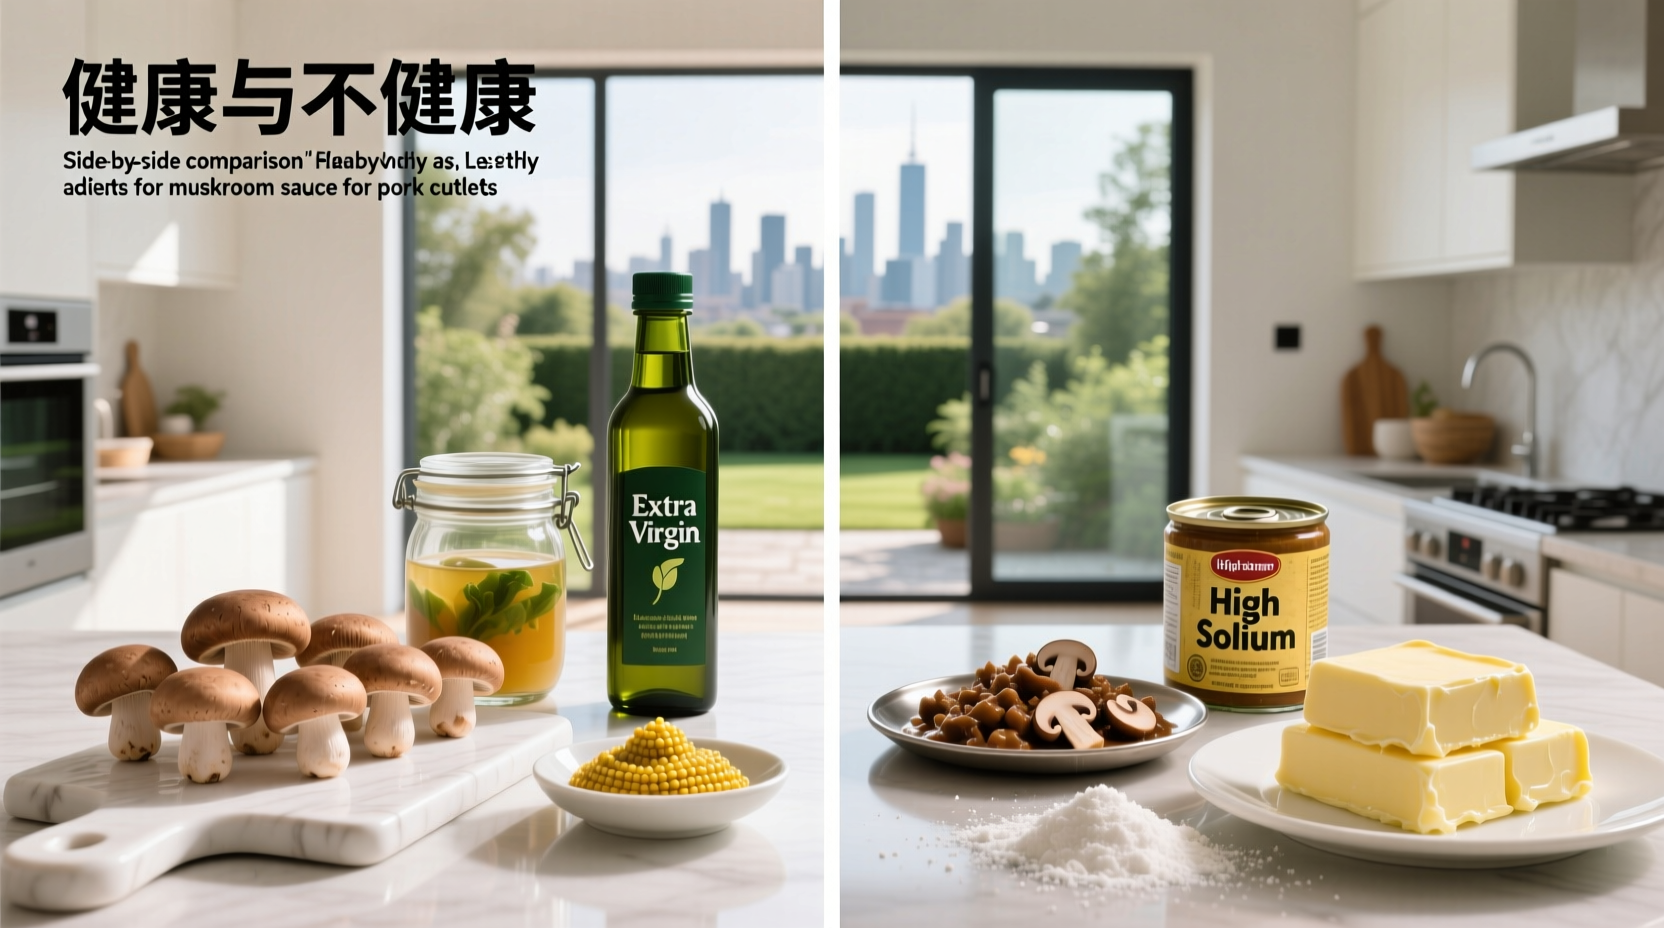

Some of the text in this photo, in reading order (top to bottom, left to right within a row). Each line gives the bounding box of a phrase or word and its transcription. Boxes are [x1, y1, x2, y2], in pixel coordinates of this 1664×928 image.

[632, 493, 697, 517] Extra
[628, 520, 701, 550] Virgin
[1210, 586, 1280, 625] High
[1196, 618, 1296, 651] Solium
